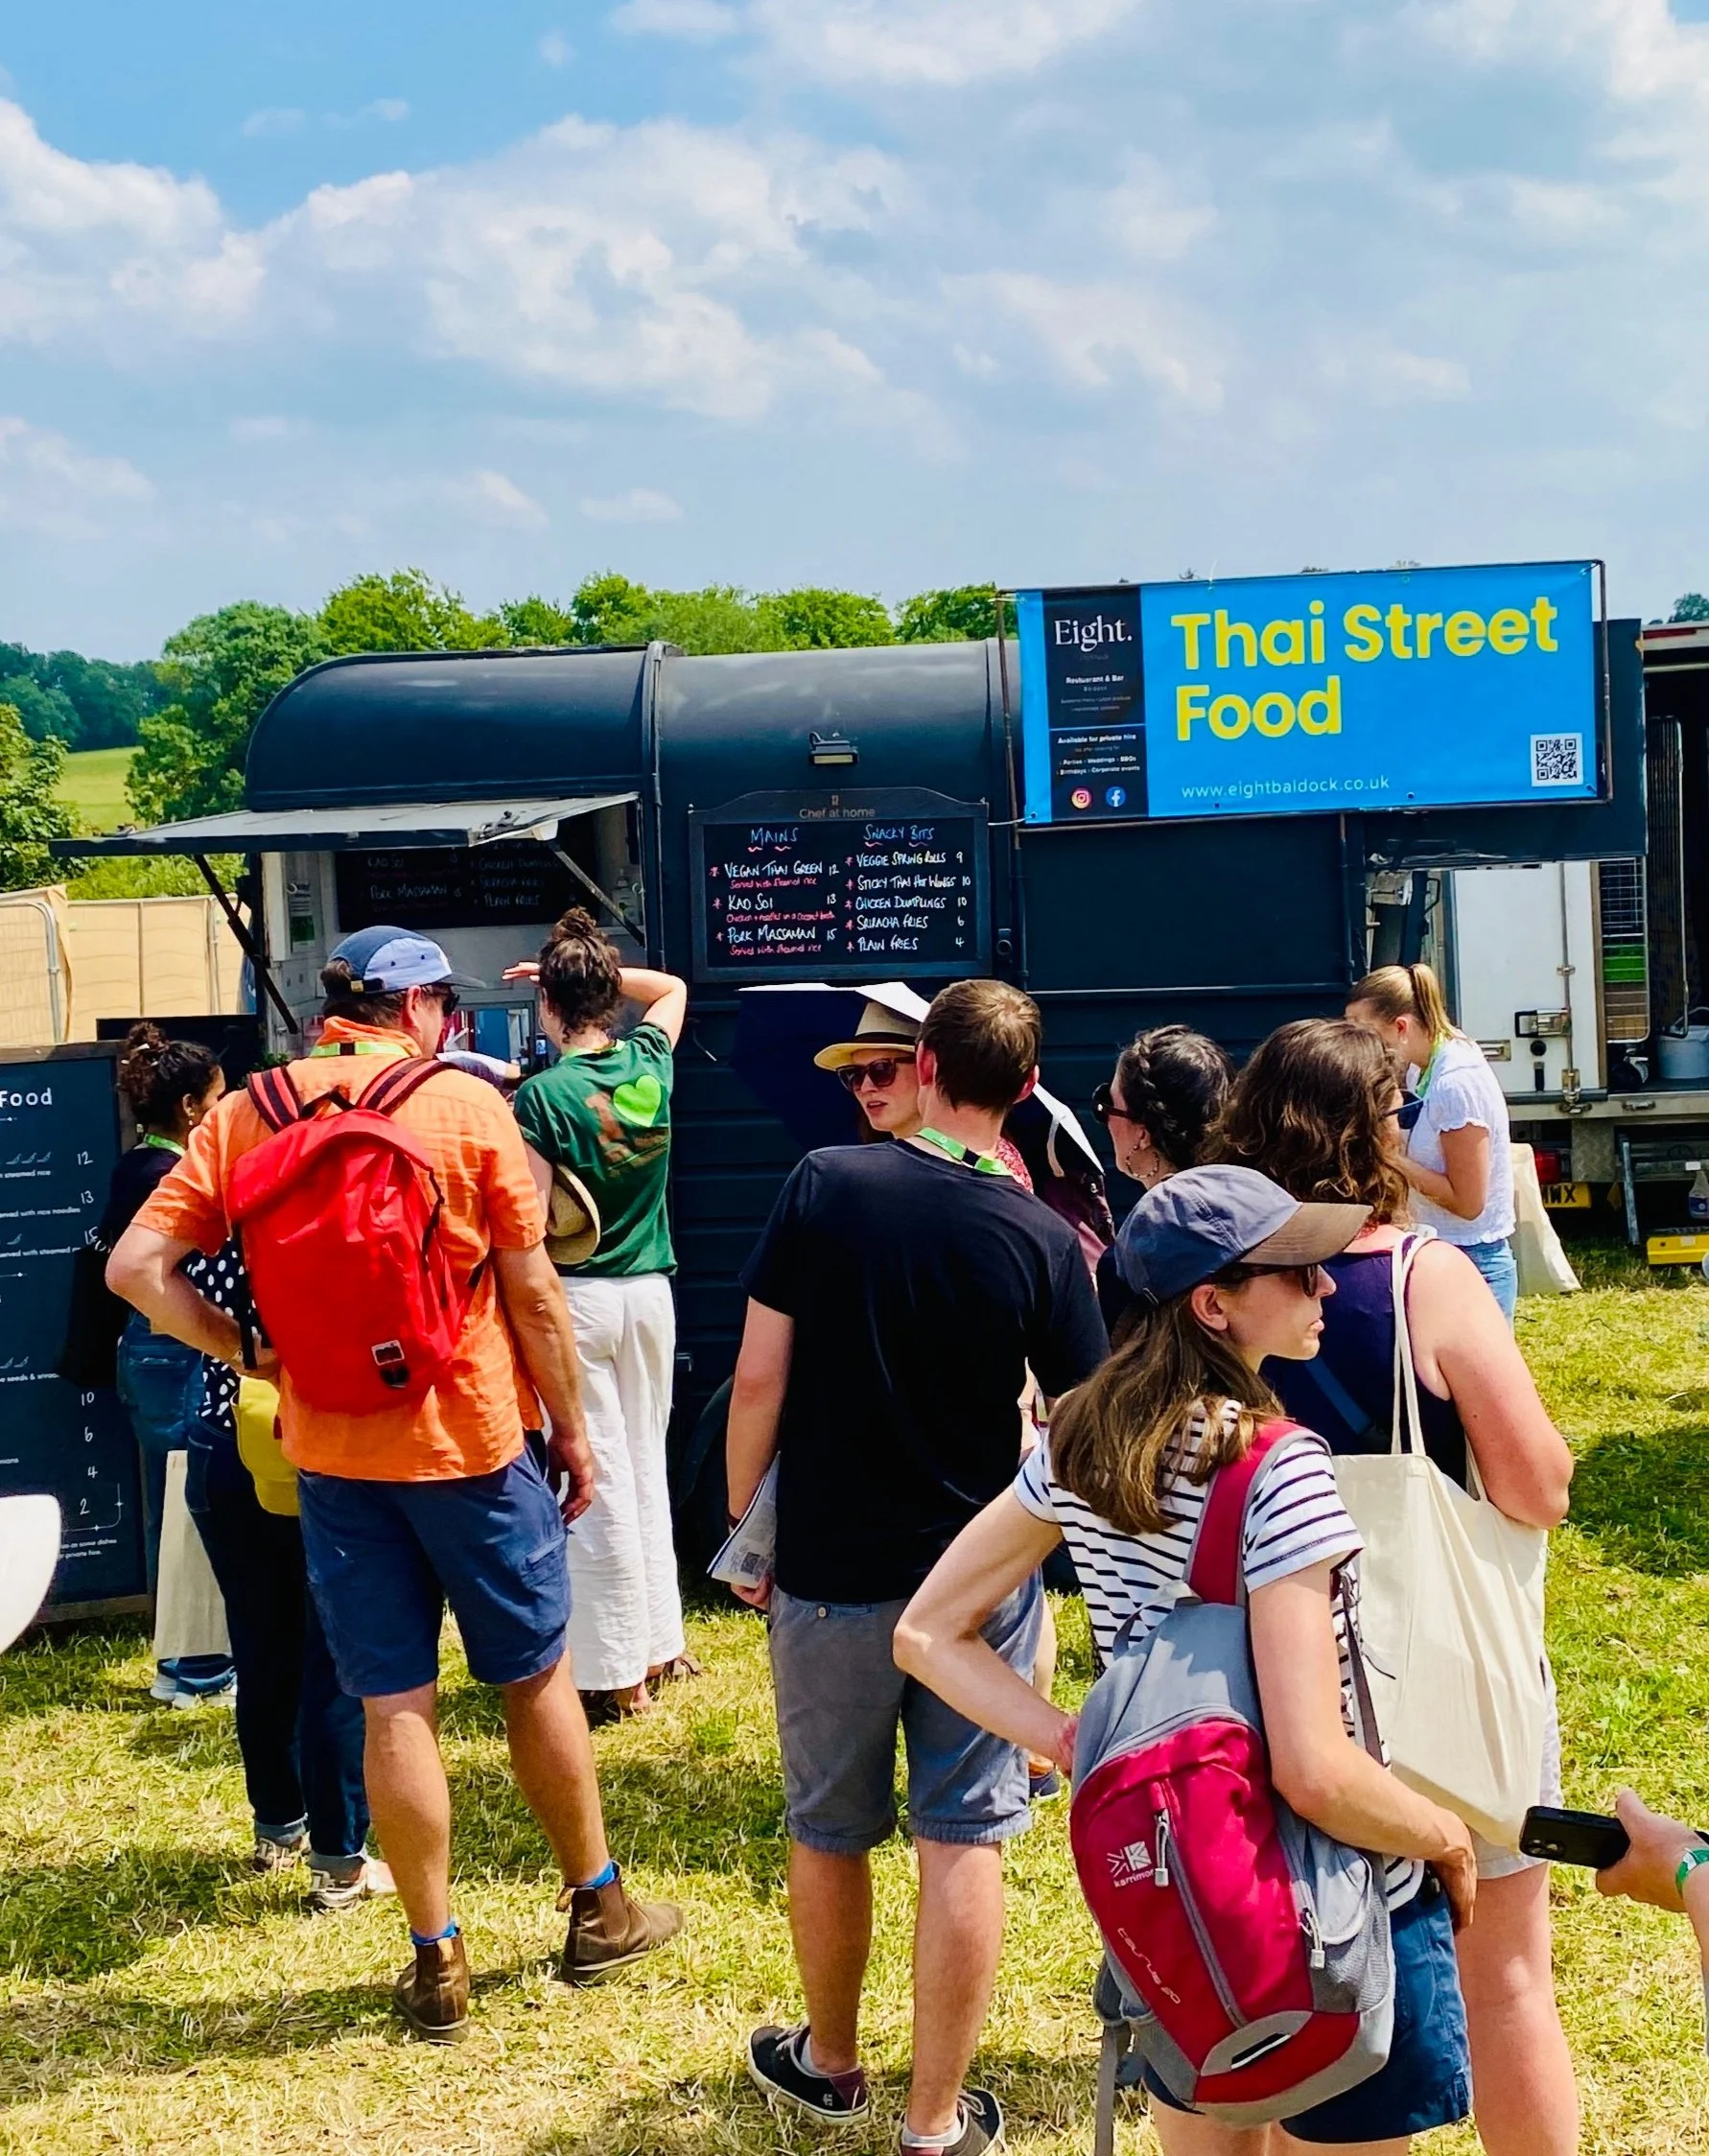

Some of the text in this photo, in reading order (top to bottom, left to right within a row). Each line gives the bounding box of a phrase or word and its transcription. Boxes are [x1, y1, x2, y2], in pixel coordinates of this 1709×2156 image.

[1054, 615, 1133, 652] Eight.
[1170, 596, 1558, 670] Thai Street
[1065, 675, 1104, 684] Restaurant
[1176, 675, 1343, 741] Food
[1182, 775, 1390, 799] www.eightbaldock.co.uk
[799, 808, 876, 819] Chef at home
[750, 828, 799, 846] MAINS
[863, 824, 935, 840] SNACKY BITS
[856, 850, 963, 867] VEGGIE SPRING ROLLS 9
[724, 860, 839, 879] VEGAN THAI GREEN 12
[857, 874, 971, 890] STICKY THAI HOT WINGS 10
[729, 892, 836, 910] KAO SOI 13
[855, 895, 967, 910] CHICKEN DUMPLINGS 10
[856, 913, 965, 930] SRIRACHA FRIES 6
[727, 924, 837, 944] PORK MASSAMAN 15
[857, 934, 965, 951] PLAIN FRIES 4
[0, 1087, 53, 1108] Food
[77, 1151, 93, 1165] 12
[81, 1190, 94, 1205] 13
[0, 1249, 21, 1257] erved
[81, 1392, 95, 1407] 10
[84, 1426, 94, 1442] 6
[87, 1465, 98, 1478] 4
[80, 1497, 90, 1515] 2
[1113, 1868, 1155, 1888] karrimor
